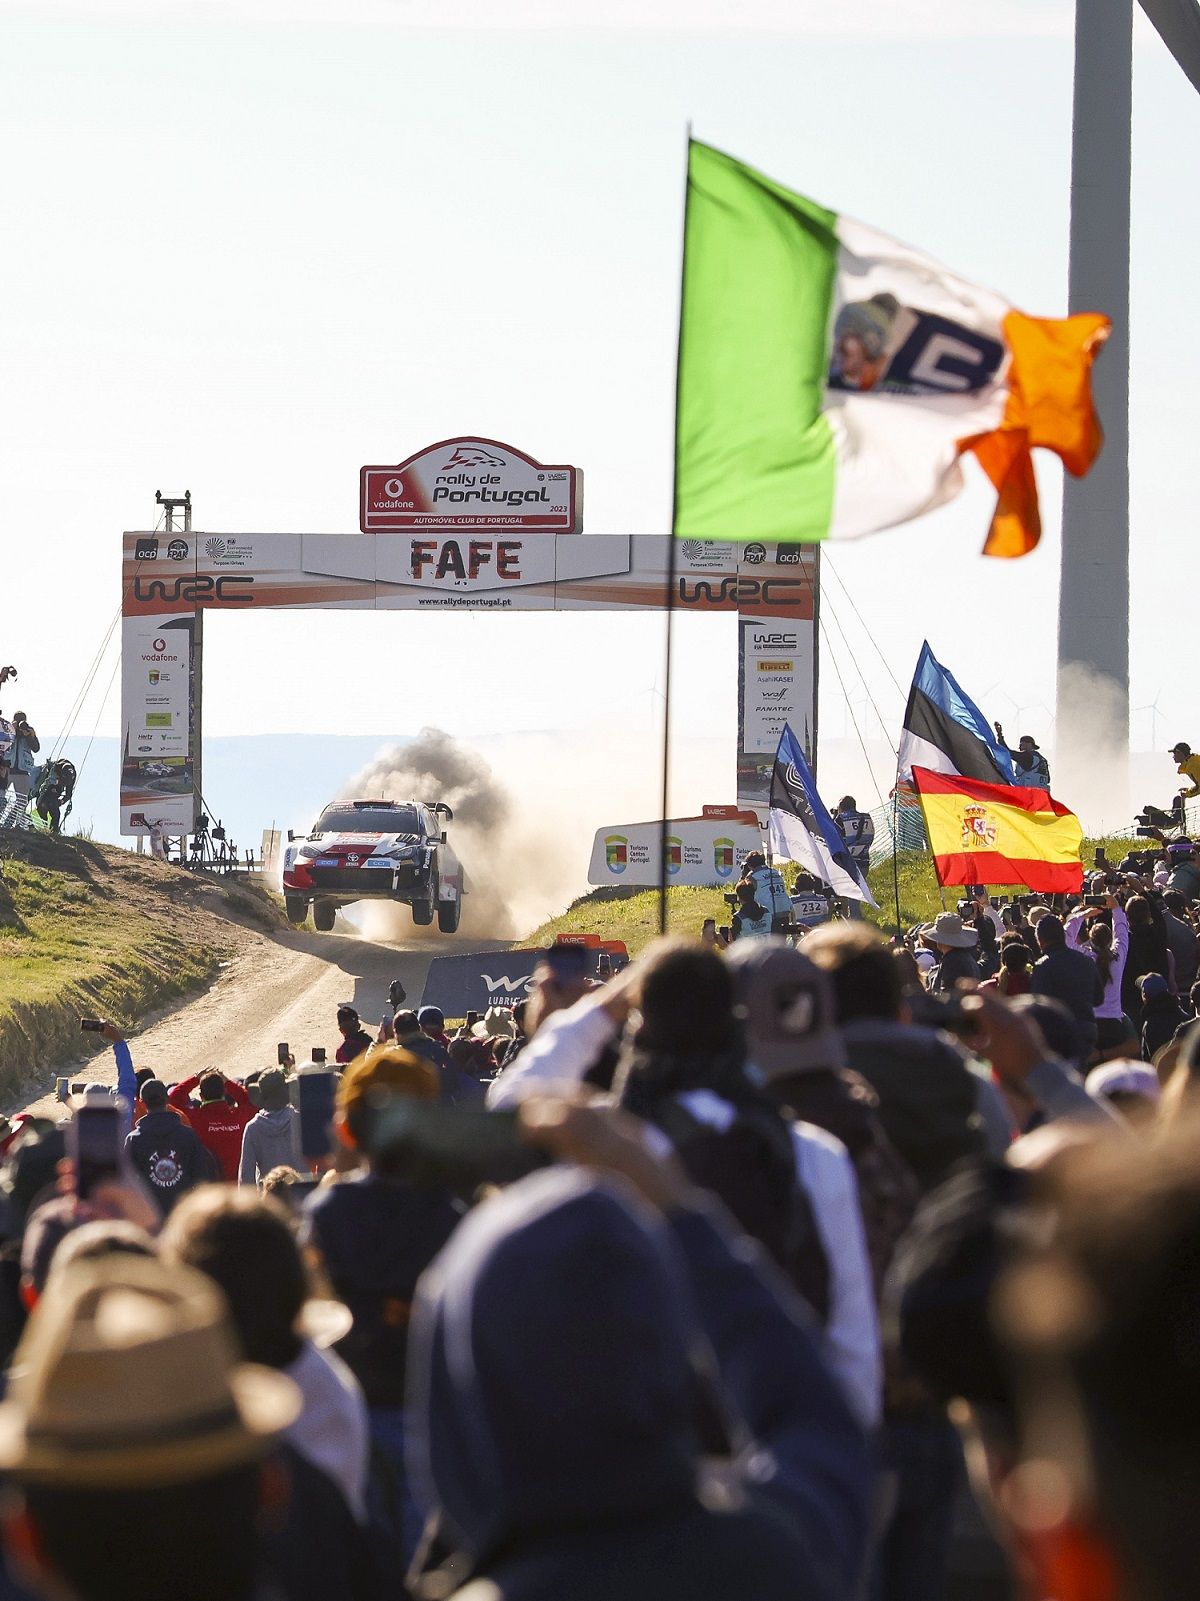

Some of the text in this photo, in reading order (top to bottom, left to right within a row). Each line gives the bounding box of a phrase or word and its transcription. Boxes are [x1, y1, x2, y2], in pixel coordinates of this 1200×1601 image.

[435, 473, 501, 487] rally de
[432, 487, 550, 506] Portugal
[373, 499, 414, 508] vodafone
[550, 505, 568, 513] 2023
[414, 516, 523, 524] AUTOMÓVEL CLUB DE PORTUGAL
[167, 549, 189, 560] FPAK
[743, 553, 766, 563] FPAK
[410, 540, 522, 580] FAFE
[135, 575, 255, 602] WRC
[679, 577, 801, 605] WRC
[418, 598, 512, 608] www.rallydeportugal.pt
[753, 633, 797, 643] WRC
[141, 653, 178, 662] vodafone
[801, 902, 821, 913] 232
[561, 936, 586, 944] WRC
[208, 1124, 241, 1132] Portugal
